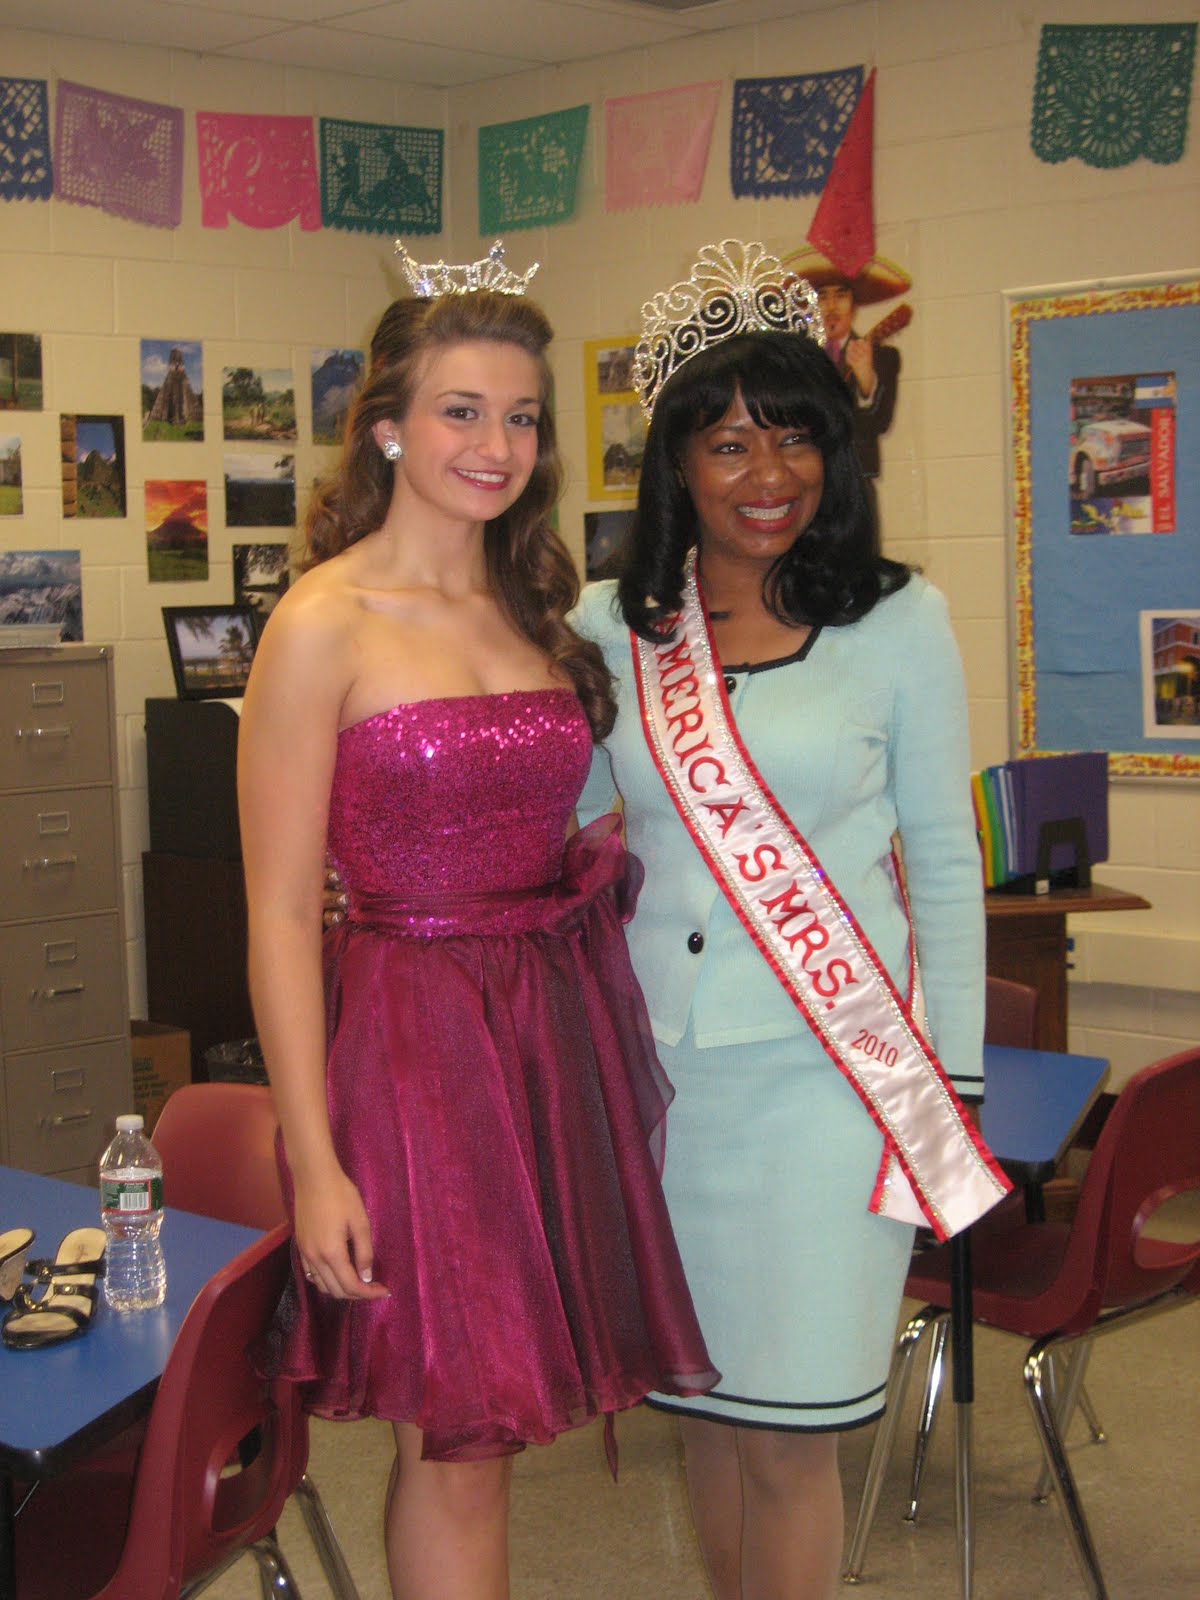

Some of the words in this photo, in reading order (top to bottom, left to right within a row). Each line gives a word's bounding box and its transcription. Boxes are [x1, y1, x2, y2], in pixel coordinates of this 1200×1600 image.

[1158, 417, 1171, 498] SALVADOR
[1158, 504, 1171, 520] EL
[758, 879, 861, 1011] MRS.
[850, 1028, 900, 1068] 2010
